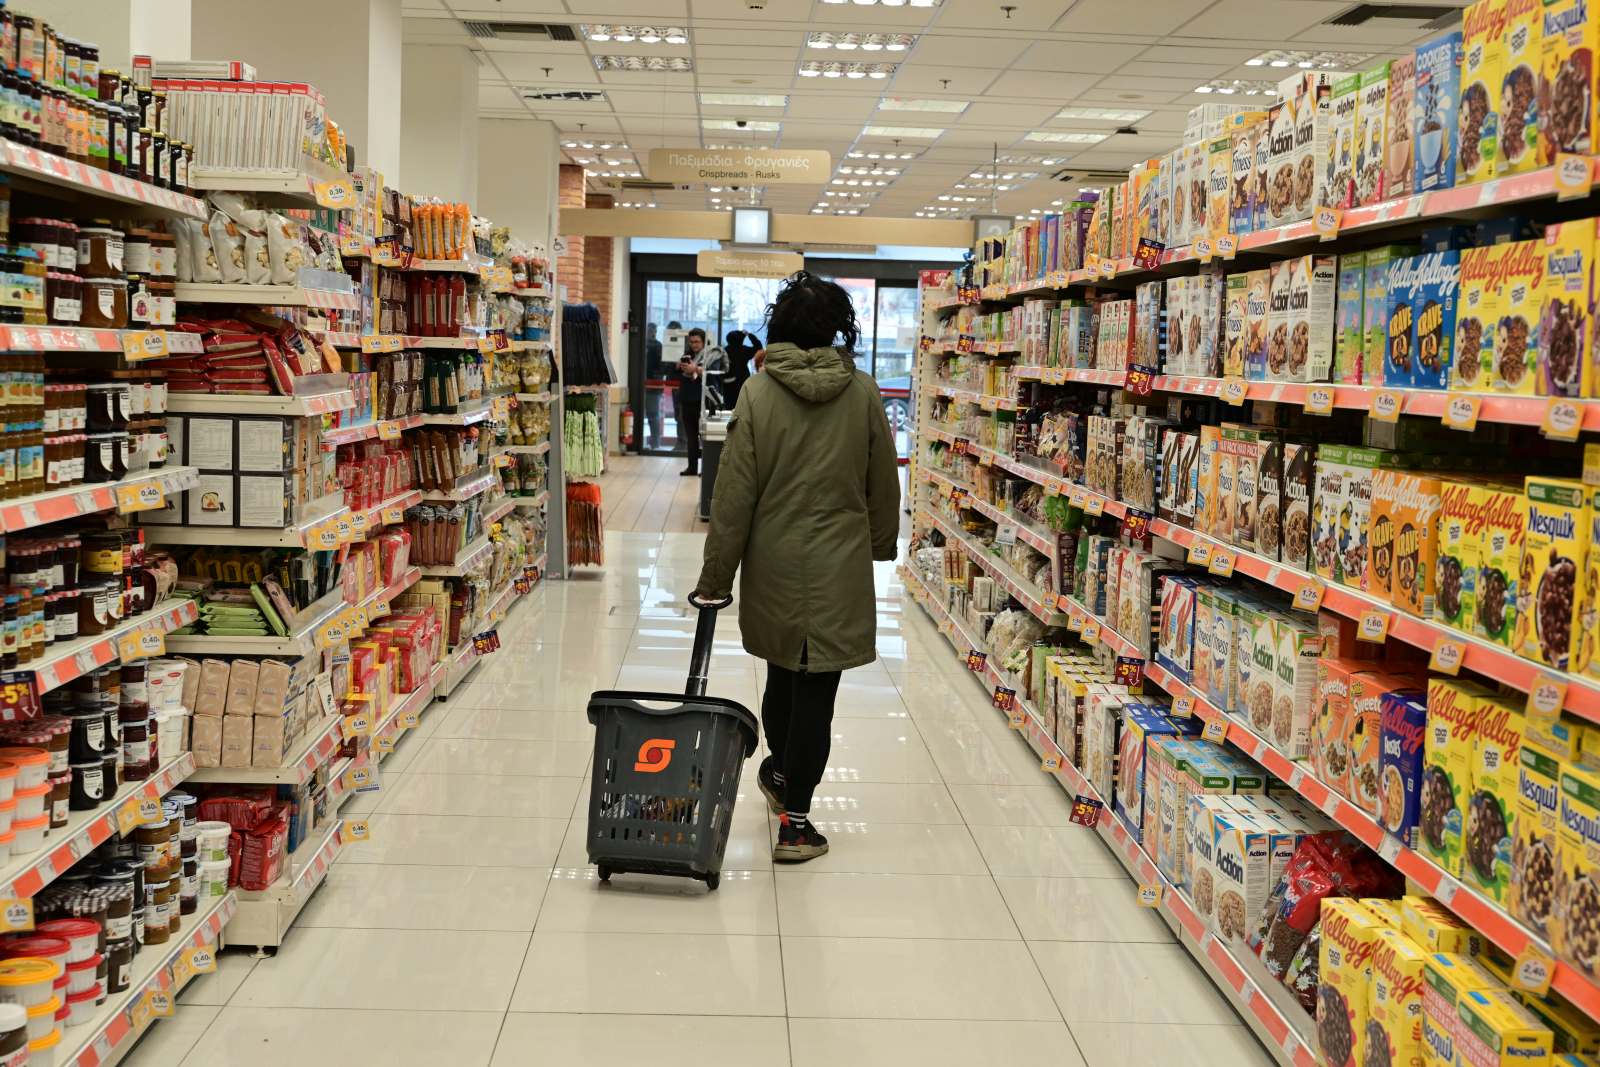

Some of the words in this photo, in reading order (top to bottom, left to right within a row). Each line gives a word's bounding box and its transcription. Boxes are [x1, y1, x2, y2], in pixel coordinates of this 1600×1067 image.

[1416, 43, 1451, 71] COOKIES
[1336, 97, 1354, 118] alpha
[1366, 86, 1386, 107] alpha
[1269, 130, 1293, 158] Action
[1295, 119, 1313, 148] Action
[669, 154, 733, 168] Παξιμάδια
[744, 155, 810, 170] Φρυγανιές
[698, 170, 748, 179] Crispbreads
[715, 256, 740, 266] Ταμεία
[1289, 285, 1308, 310] Action
[1390, 306, 1412, 338] KRAVE
[1418, 303, 1442, 337] KRAVE
[1247, 444, 1258, 458] PACK
[1258, 471, 1278, 496] Action
[1284, 474, 1307, 502] Action
[1349, 482, 1372, 500] Pillow
[1372, 520, 1394, 548] KRAVE
[1528, 505, 1575, 544] Nesquik
[1396, 530, 1419, 558] KRAVE
[1320, 624, 1339, 640] Sweetos
[1252, 642, 1274, 672] Action
[1276, 654, 1294, 686] Action
[0, 684, 29, 704] -5%
[1320, 678, 1348, 700] Sweetos
[1194, 826, 1212, 862] Action
[1216, 846, 1244, 884] Action
[1506, 1045, 1546, 1059] Nesquik
